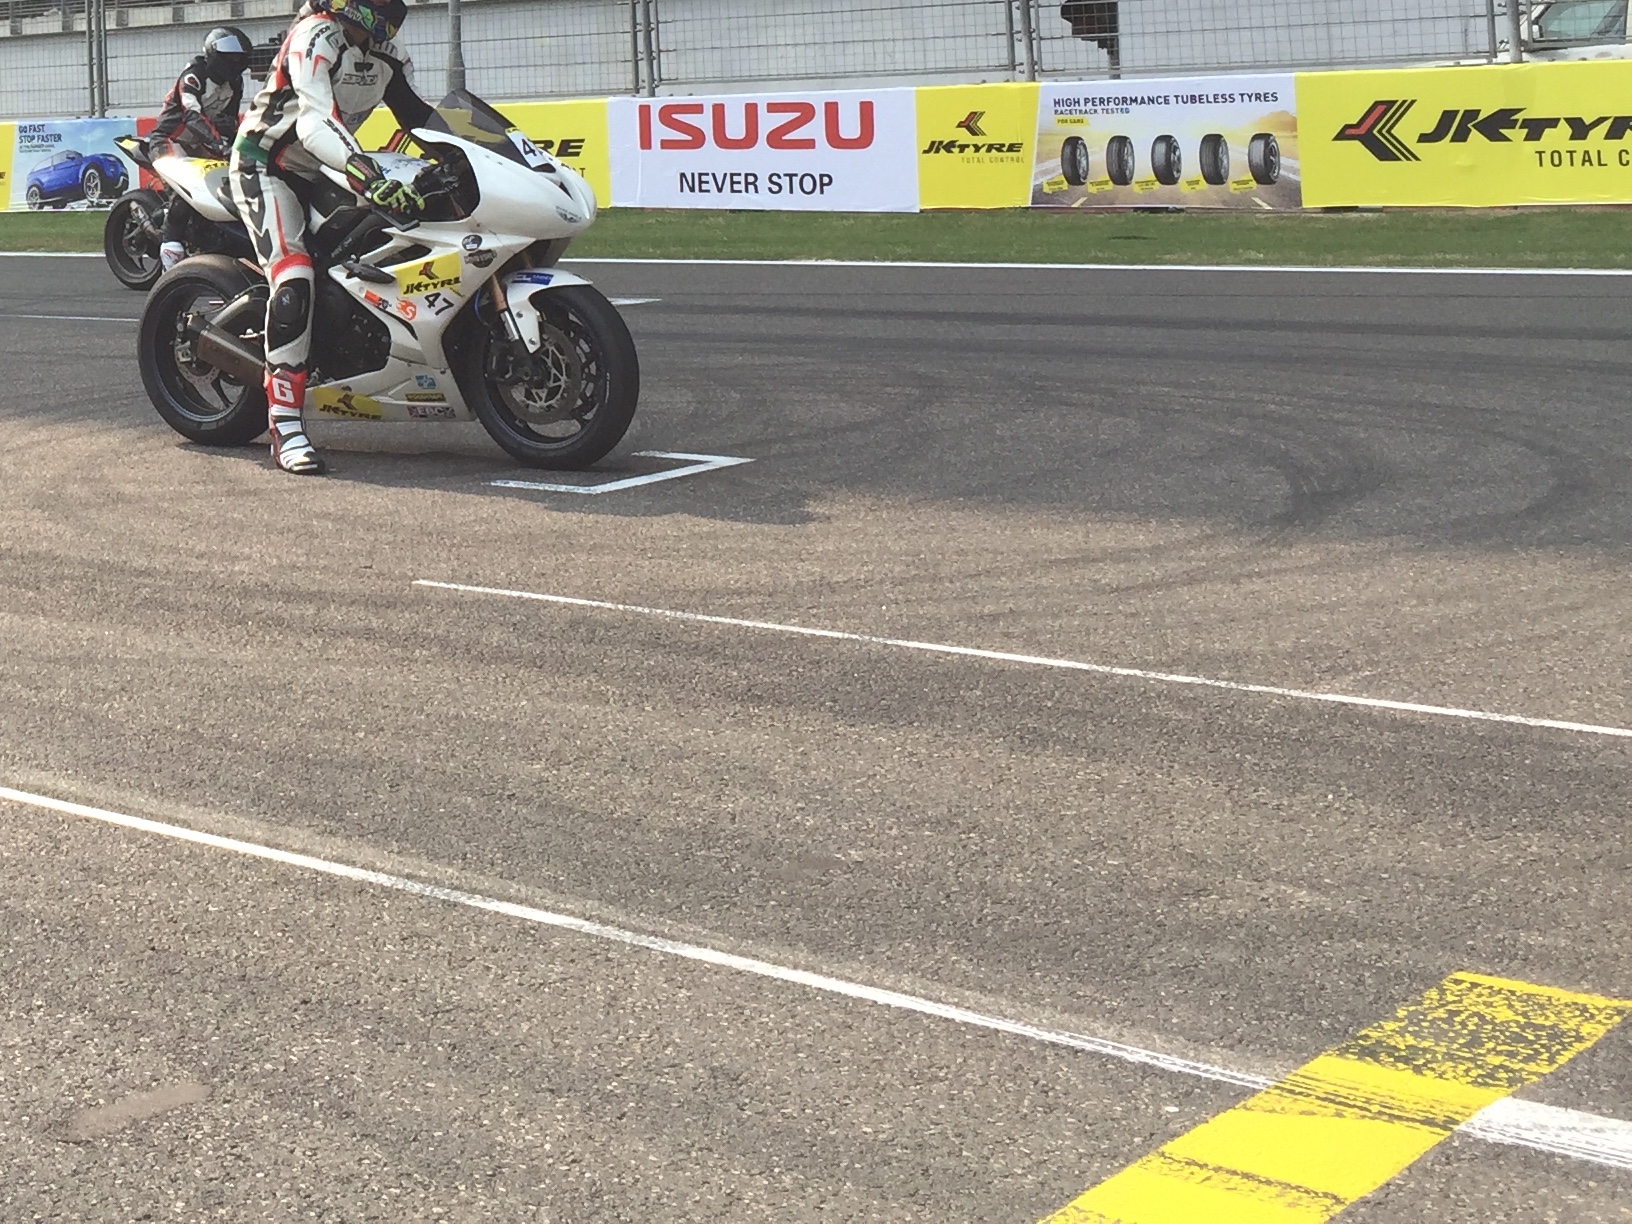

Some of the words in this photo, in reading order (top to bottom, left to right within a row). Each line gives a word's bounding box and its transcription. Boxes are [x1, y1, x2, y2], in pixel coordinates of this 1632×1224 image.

[1053, 97, 1082, 108] HIGH
[1084, 94, 1171, 107] PERFORMANCE
[1174, 93, 1236, 105] TUBELESS
[1238, 91, 1279, 103] TYRES
[1053, 108, 1099, 116] RACETRACK
[18, 124, 28, 134] GO
[28, 123, 46, 133] FAST
[638, 99, 875, 151] ISUZU
[1415, 107, 1632, 144] JKTY
[18, 134, 36, 145] STOP
[36, 133, 63, 143] FASTER
[1534, 149, 1608, 168] TOTAL
[678, 172, 760, 195] NEVER
[767, 172, 834, 196] STOP
[423, 291, 455, 317] 47
[271, 377, 295, 404] G
